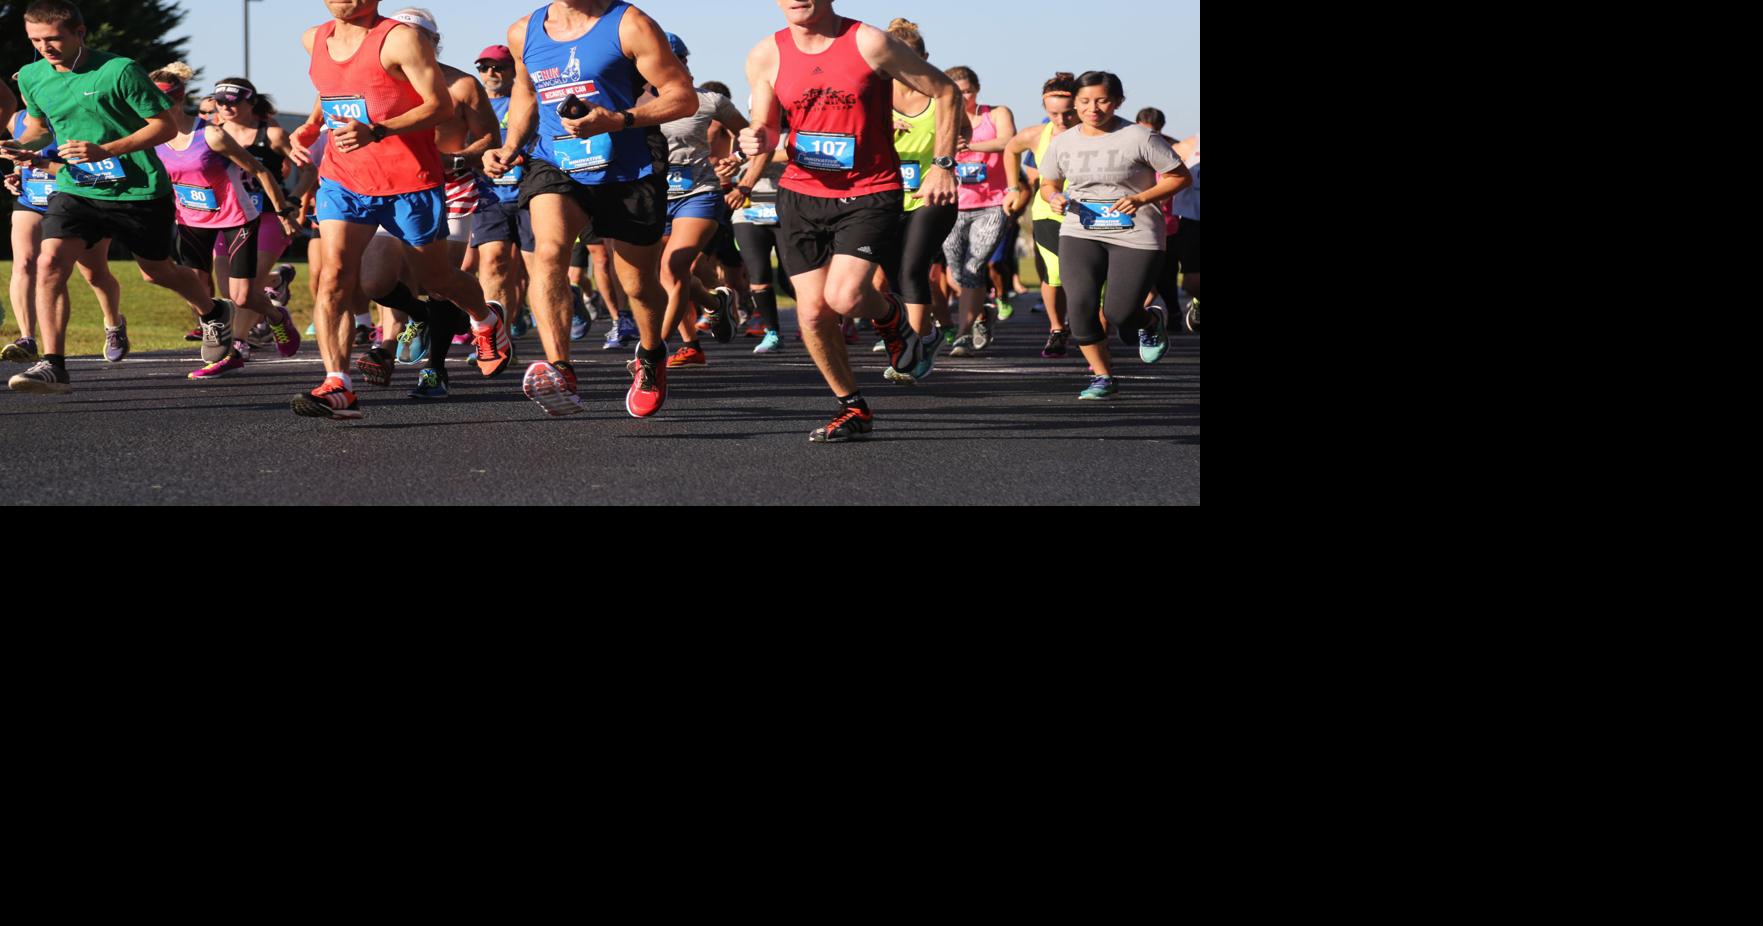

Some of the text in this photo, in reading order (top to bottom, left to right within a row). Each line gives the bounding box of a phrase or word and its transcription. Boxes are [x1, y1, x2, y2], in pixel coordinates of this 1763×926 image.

[333, 103, 362, 119] 120
[580, 139, 592, 155] 7
[811, 139, 848, 157] 107
[83, 157, 115, 172] 115
[190, 190, 207, 202] 80
